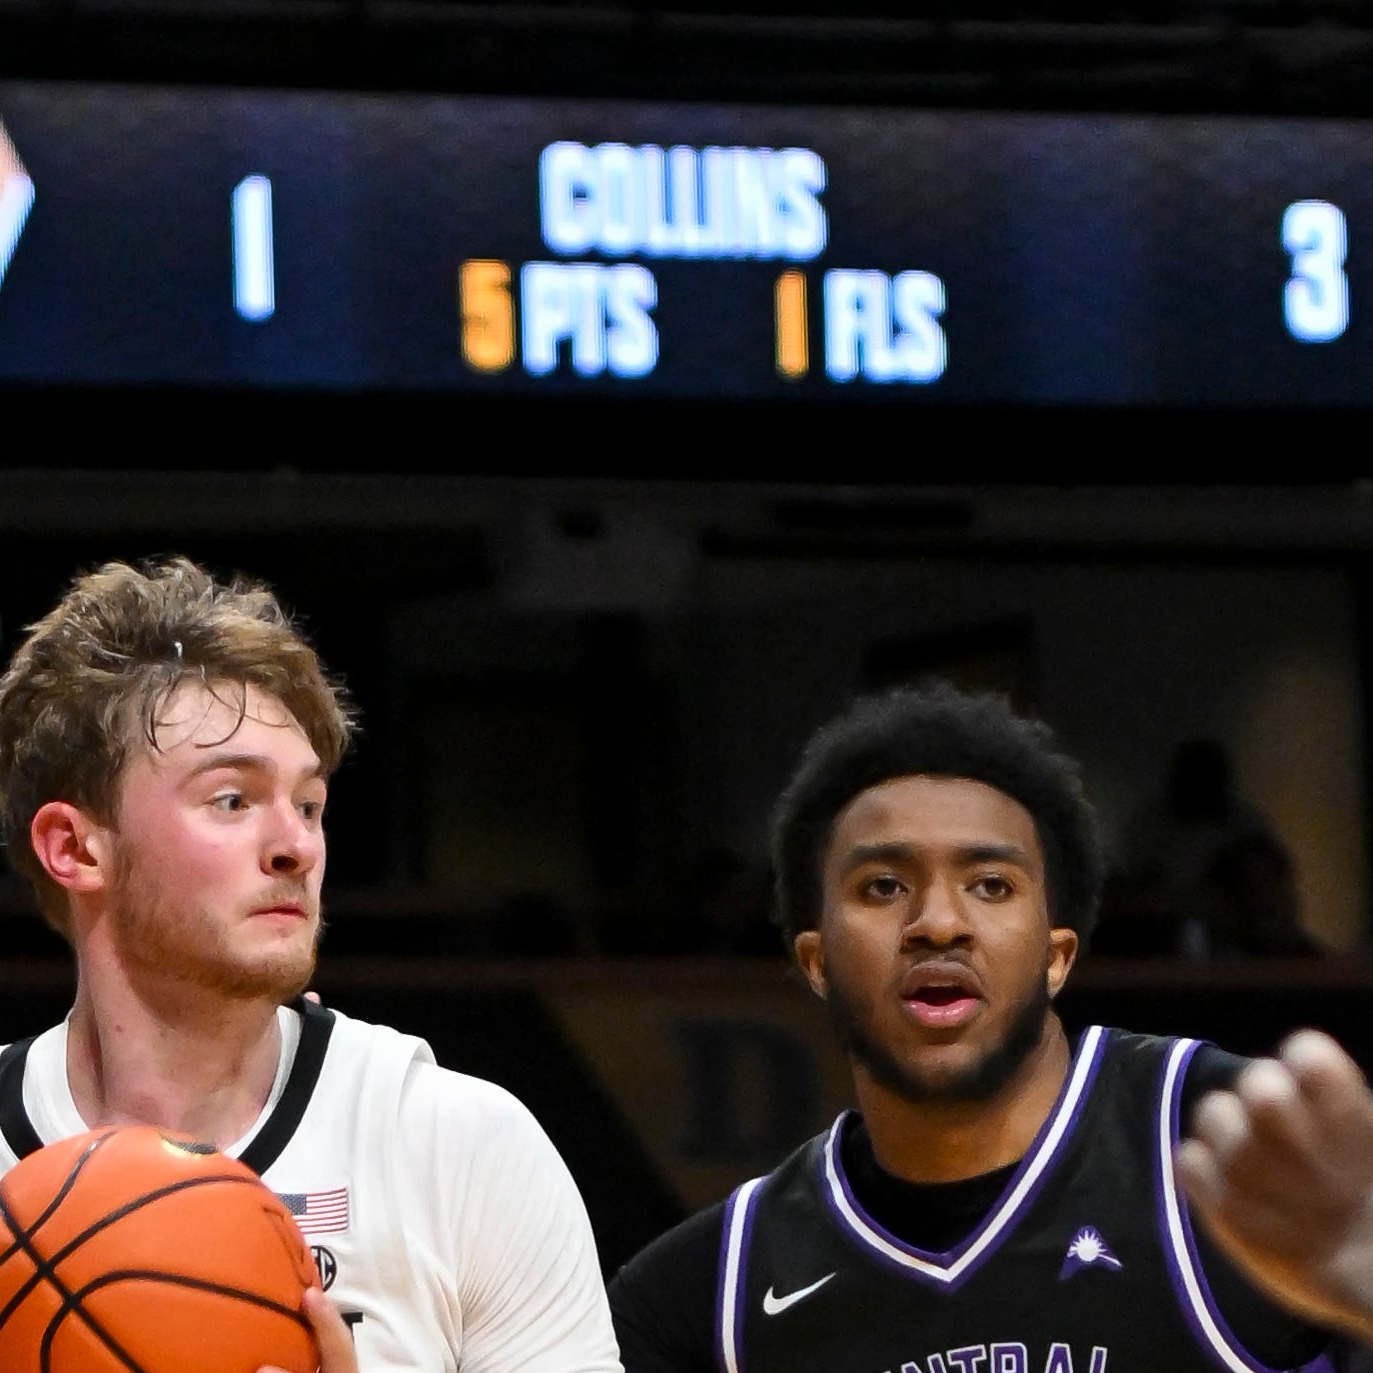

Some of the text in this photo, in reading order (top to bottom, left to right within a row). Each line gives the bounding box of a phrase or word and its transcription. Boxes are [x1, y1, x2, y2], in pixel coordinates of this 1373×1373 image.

[539, 141, 827, 261] COLLINS
[459, 259, 515, 374] 5
[521, 261, 659, 378] PTS
[824, 268, 947, 384] FLS
[1283, 200, 1348, 342] 3
